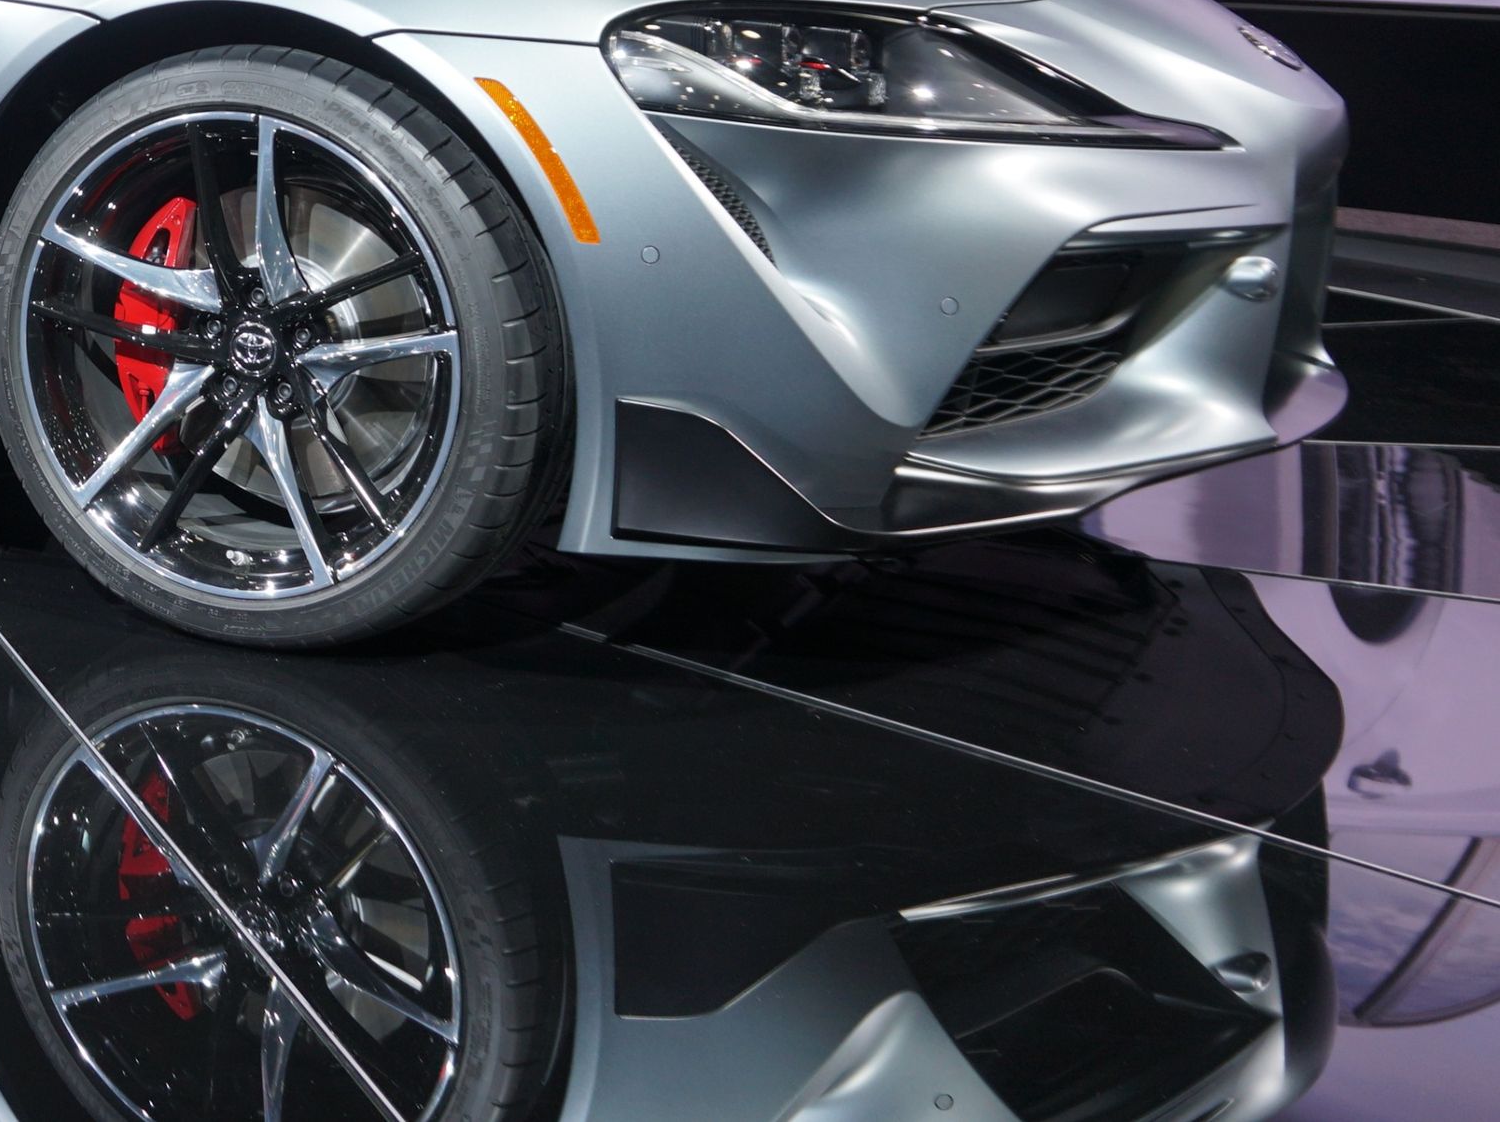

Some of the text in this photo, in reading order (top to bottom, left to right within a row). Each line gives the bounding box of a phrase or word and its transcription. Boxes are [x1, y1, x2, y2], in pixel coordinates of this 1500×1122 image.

[325, 100, 461, 239] Pilot Super Sport
[353, 517, 456, 616] MICHELIN
